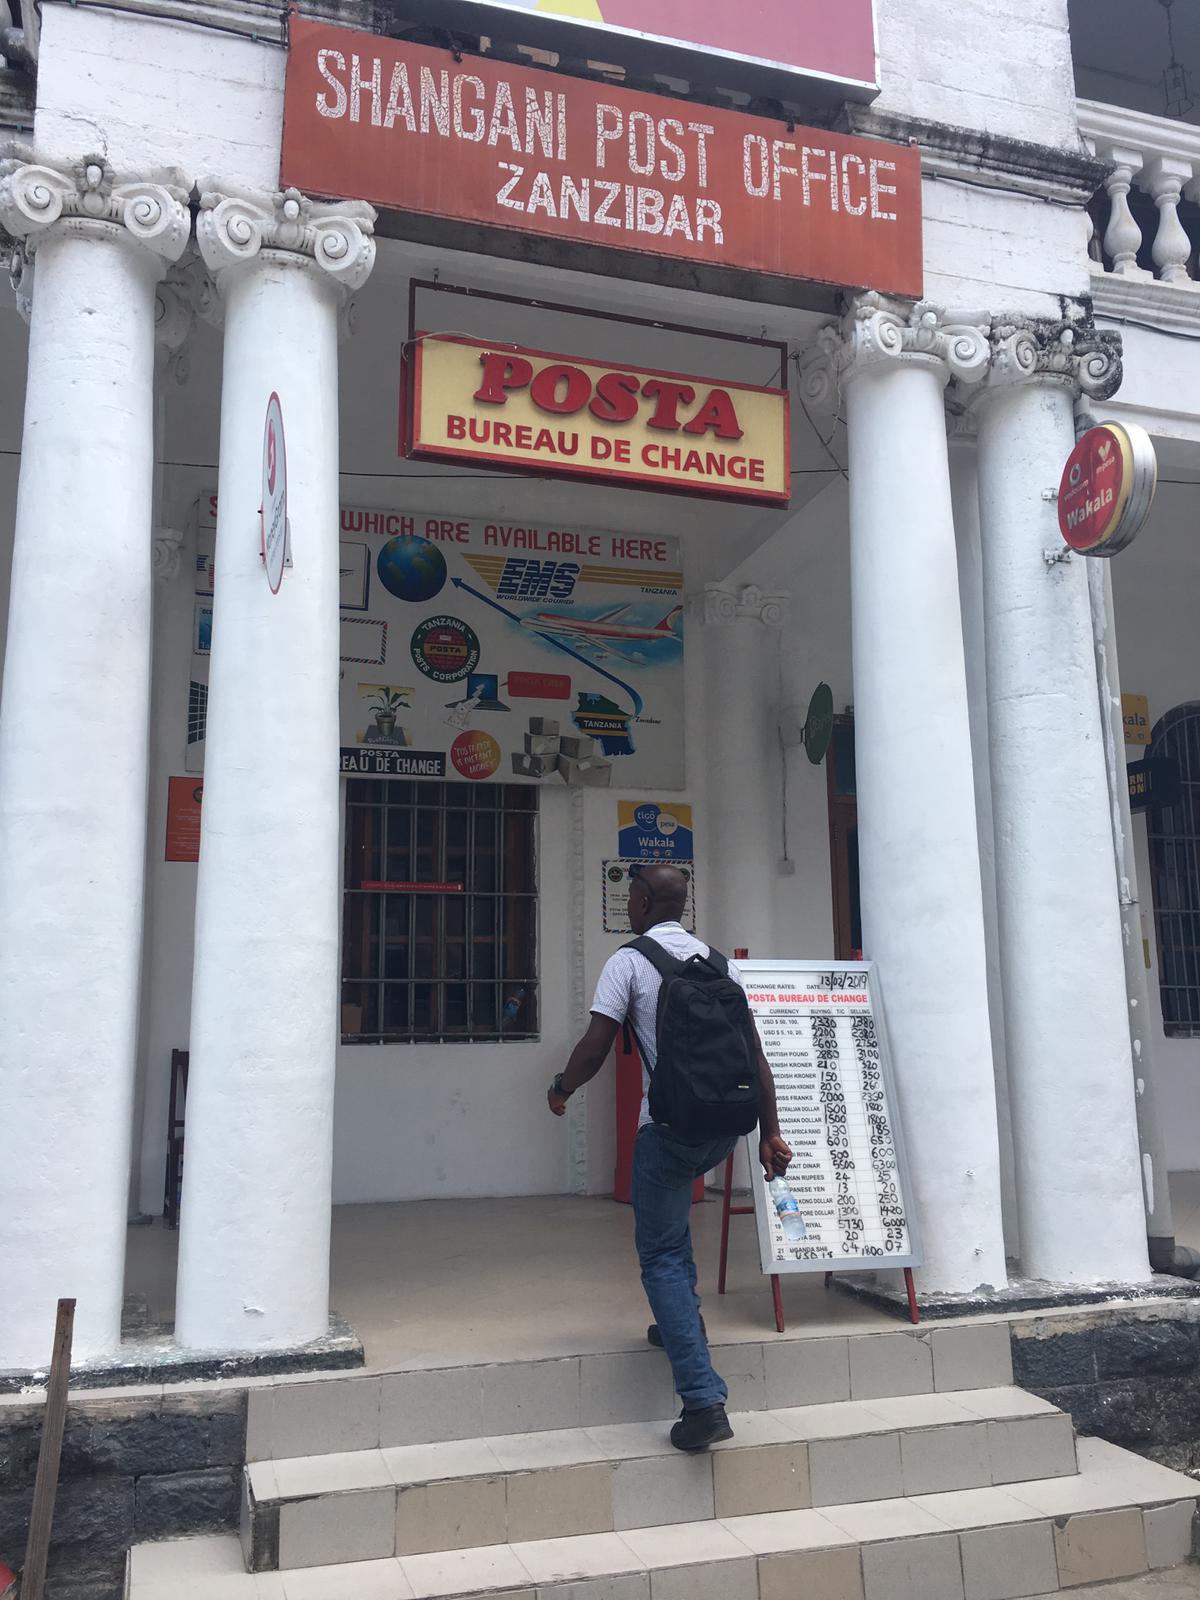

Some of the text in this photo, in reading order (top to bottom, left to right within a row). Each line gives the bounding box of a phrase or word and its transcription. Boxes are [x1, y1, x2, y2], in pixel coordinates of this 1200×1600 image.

[315, 49, 897, 222] SHANGANI POST OFFICE
[496, 161, 724, 245] ZANZIBAR
[473, 351, 744, 440] POSTA
[446, 414, 765, 483] BUREAU DE CHANGE
[1067, 487, 1113, 530] Wakala
[340, 510, 667, 561] WHICH ARE AVAILABLE HERE
[497, 557, 581, 599] EMS
[640, 586, 678, 596] TANZANIA
[496, 594, 540, 603] WORLDWIDE
[422, 617, 466, 632] TANZANIA
[430, 645, 461, 654] POSTA
[413, 648, 478, 681] POSTS CORPORATION
[584, 720, 622, 729] TANZANIA
[1122, 713, 1146, 726] kala
[359, 750, 400, 758] POSTA
[341, 756, 441, 775] EAU DE CHANGE
[638, 837, 675, 848] Wakala
[747, 994, 868, 1003] POSTA BUREAU DE CHANGE
[820, 1072, 837, 1082] 150
[862, 1071, 880, 1080] 350
[830, 1150, 849, 1160] 500
[883, 1182, 896, 1194] 20
[846, 1231, 858, 1240] 20
[887, 1229, 903, 1239] 23
